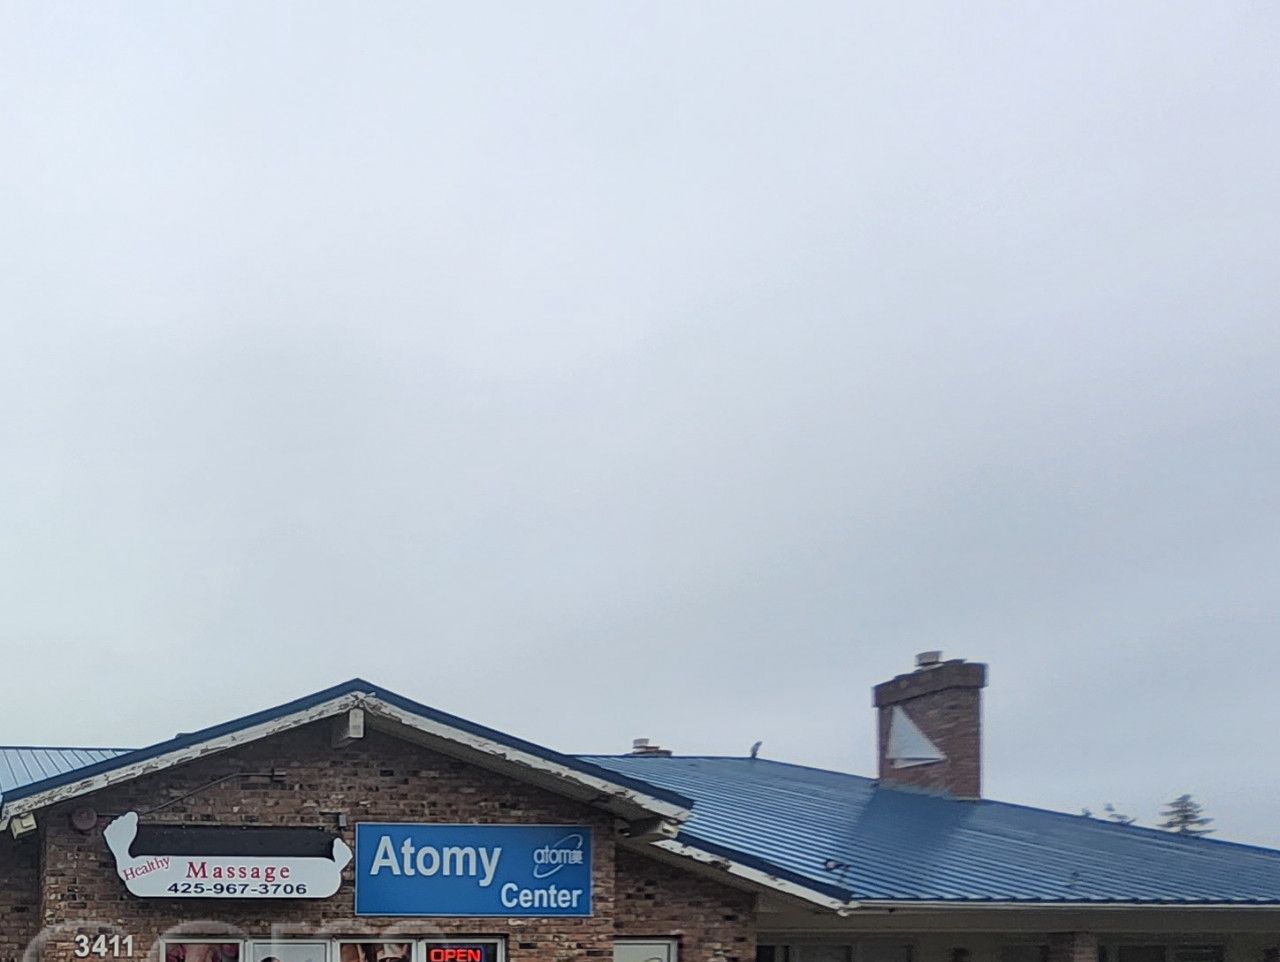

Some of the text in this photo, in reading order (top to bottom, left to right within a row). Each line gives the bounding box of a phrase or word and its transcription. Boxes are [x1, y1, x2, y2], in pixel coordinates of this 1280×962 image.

[123, 856, 290, 882] Healthy Massage
[370, 835, 502, 887] Atomy
[167, 882, 307, 895] 425-967-3706
[501, 883, 583, 908] Center
[75, 934, 133, 957] 3411
[430, 948, 481, 962] OPEN
